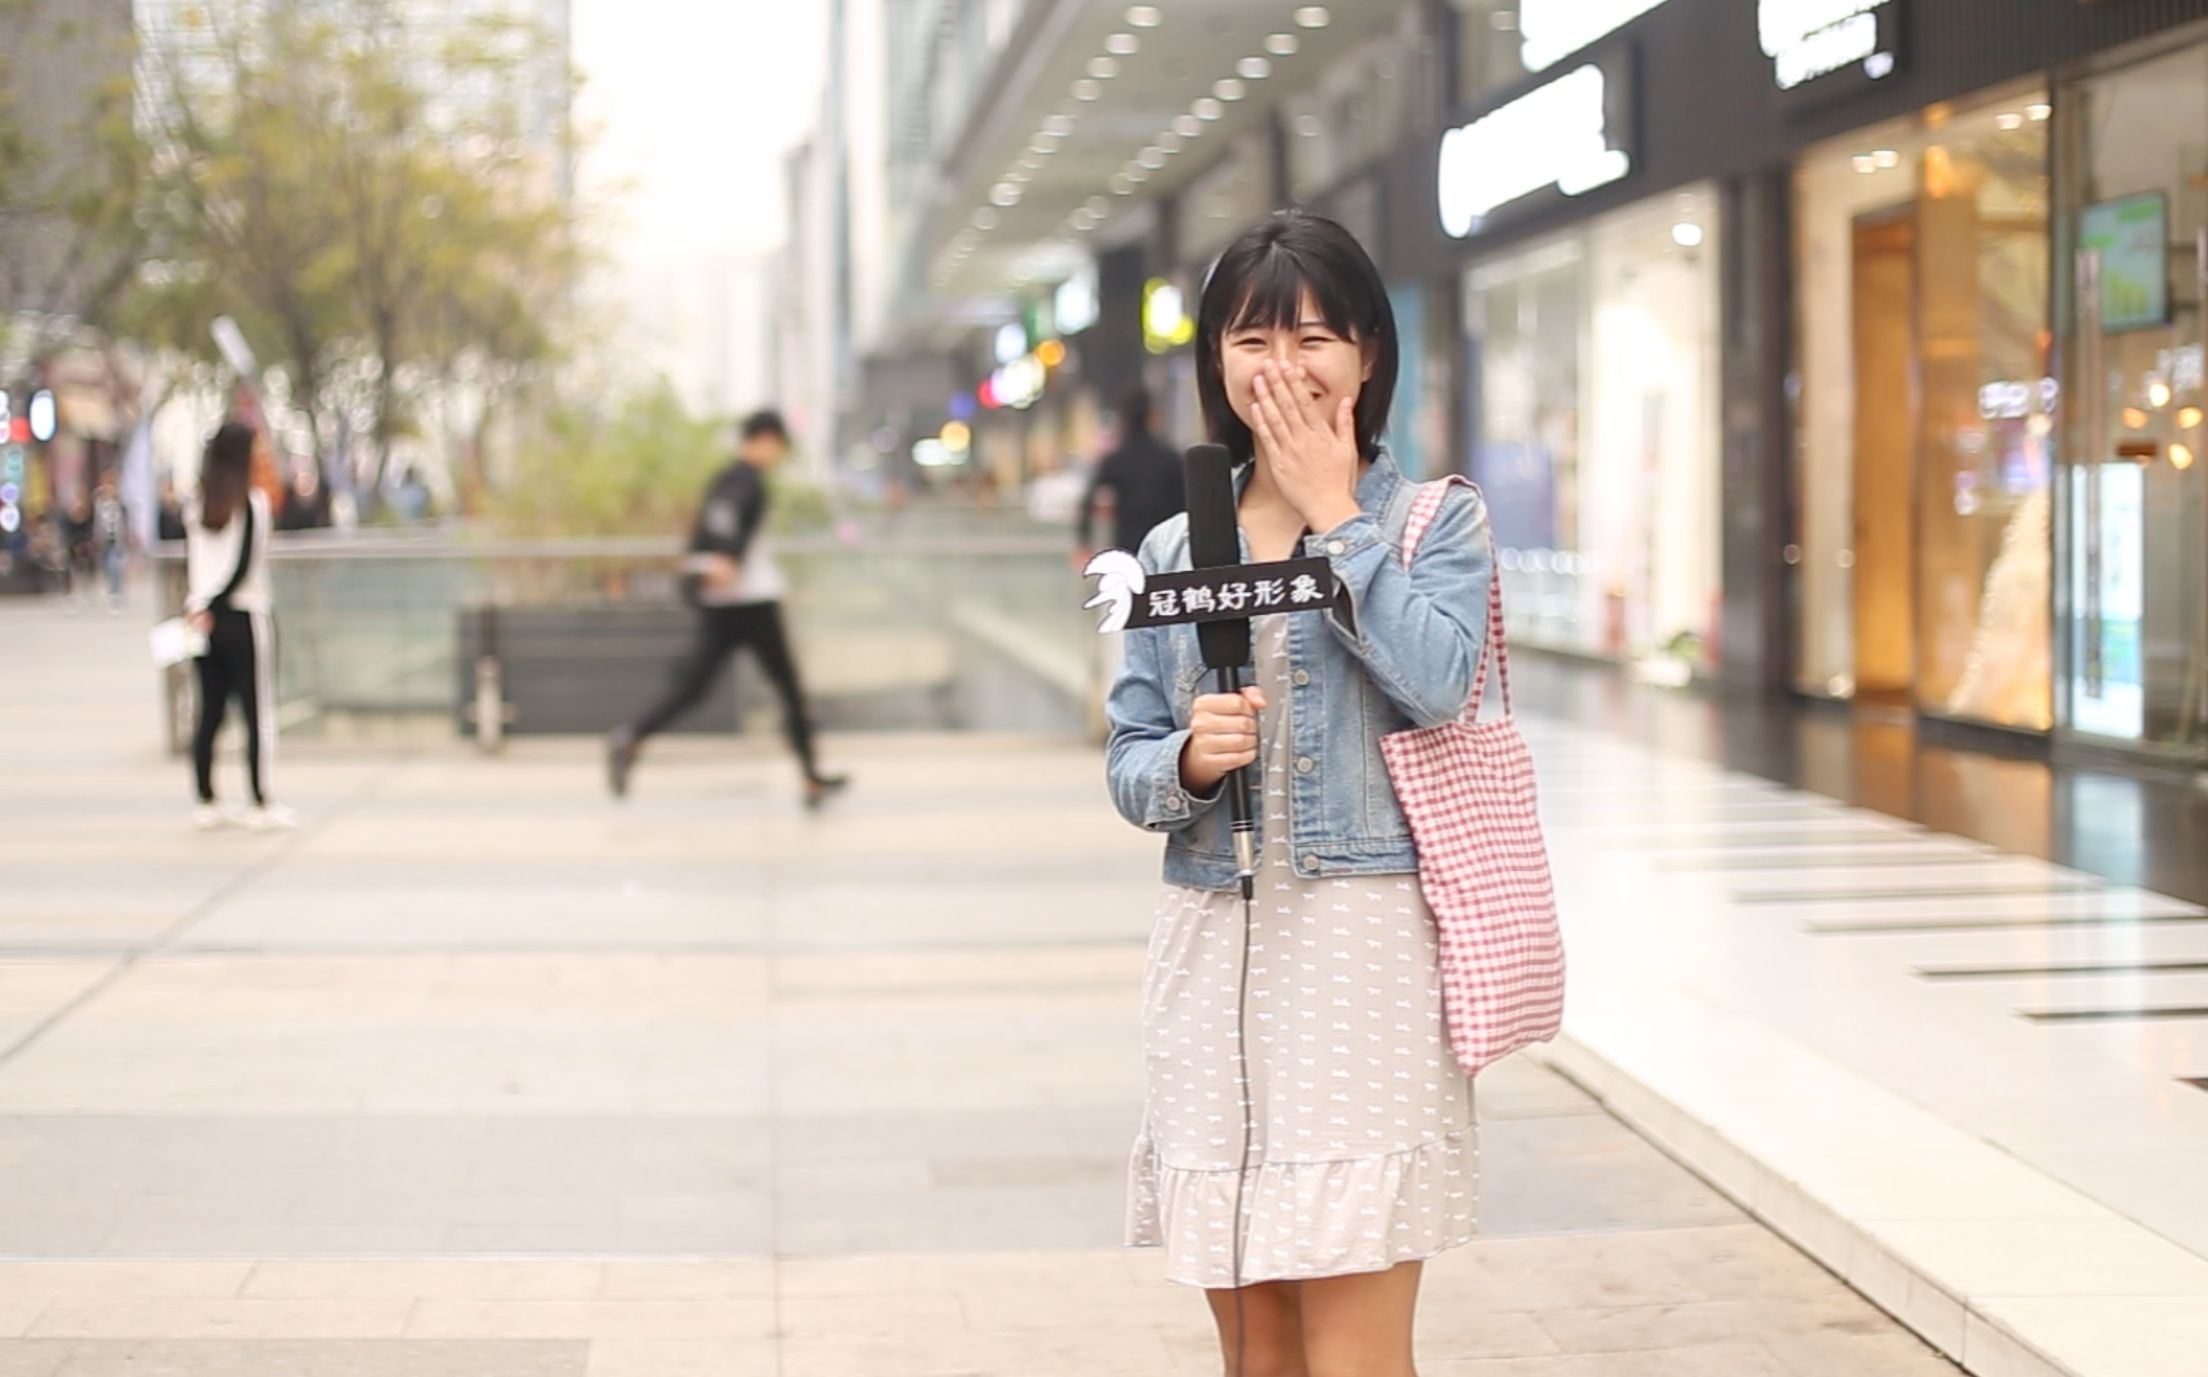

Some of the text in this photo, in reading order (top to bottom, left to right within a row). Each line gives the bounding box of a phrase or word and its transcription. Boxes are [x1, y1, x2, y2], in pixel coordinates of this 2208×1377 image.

[1149, 574, 1324, 617] 冠鹤好形象
